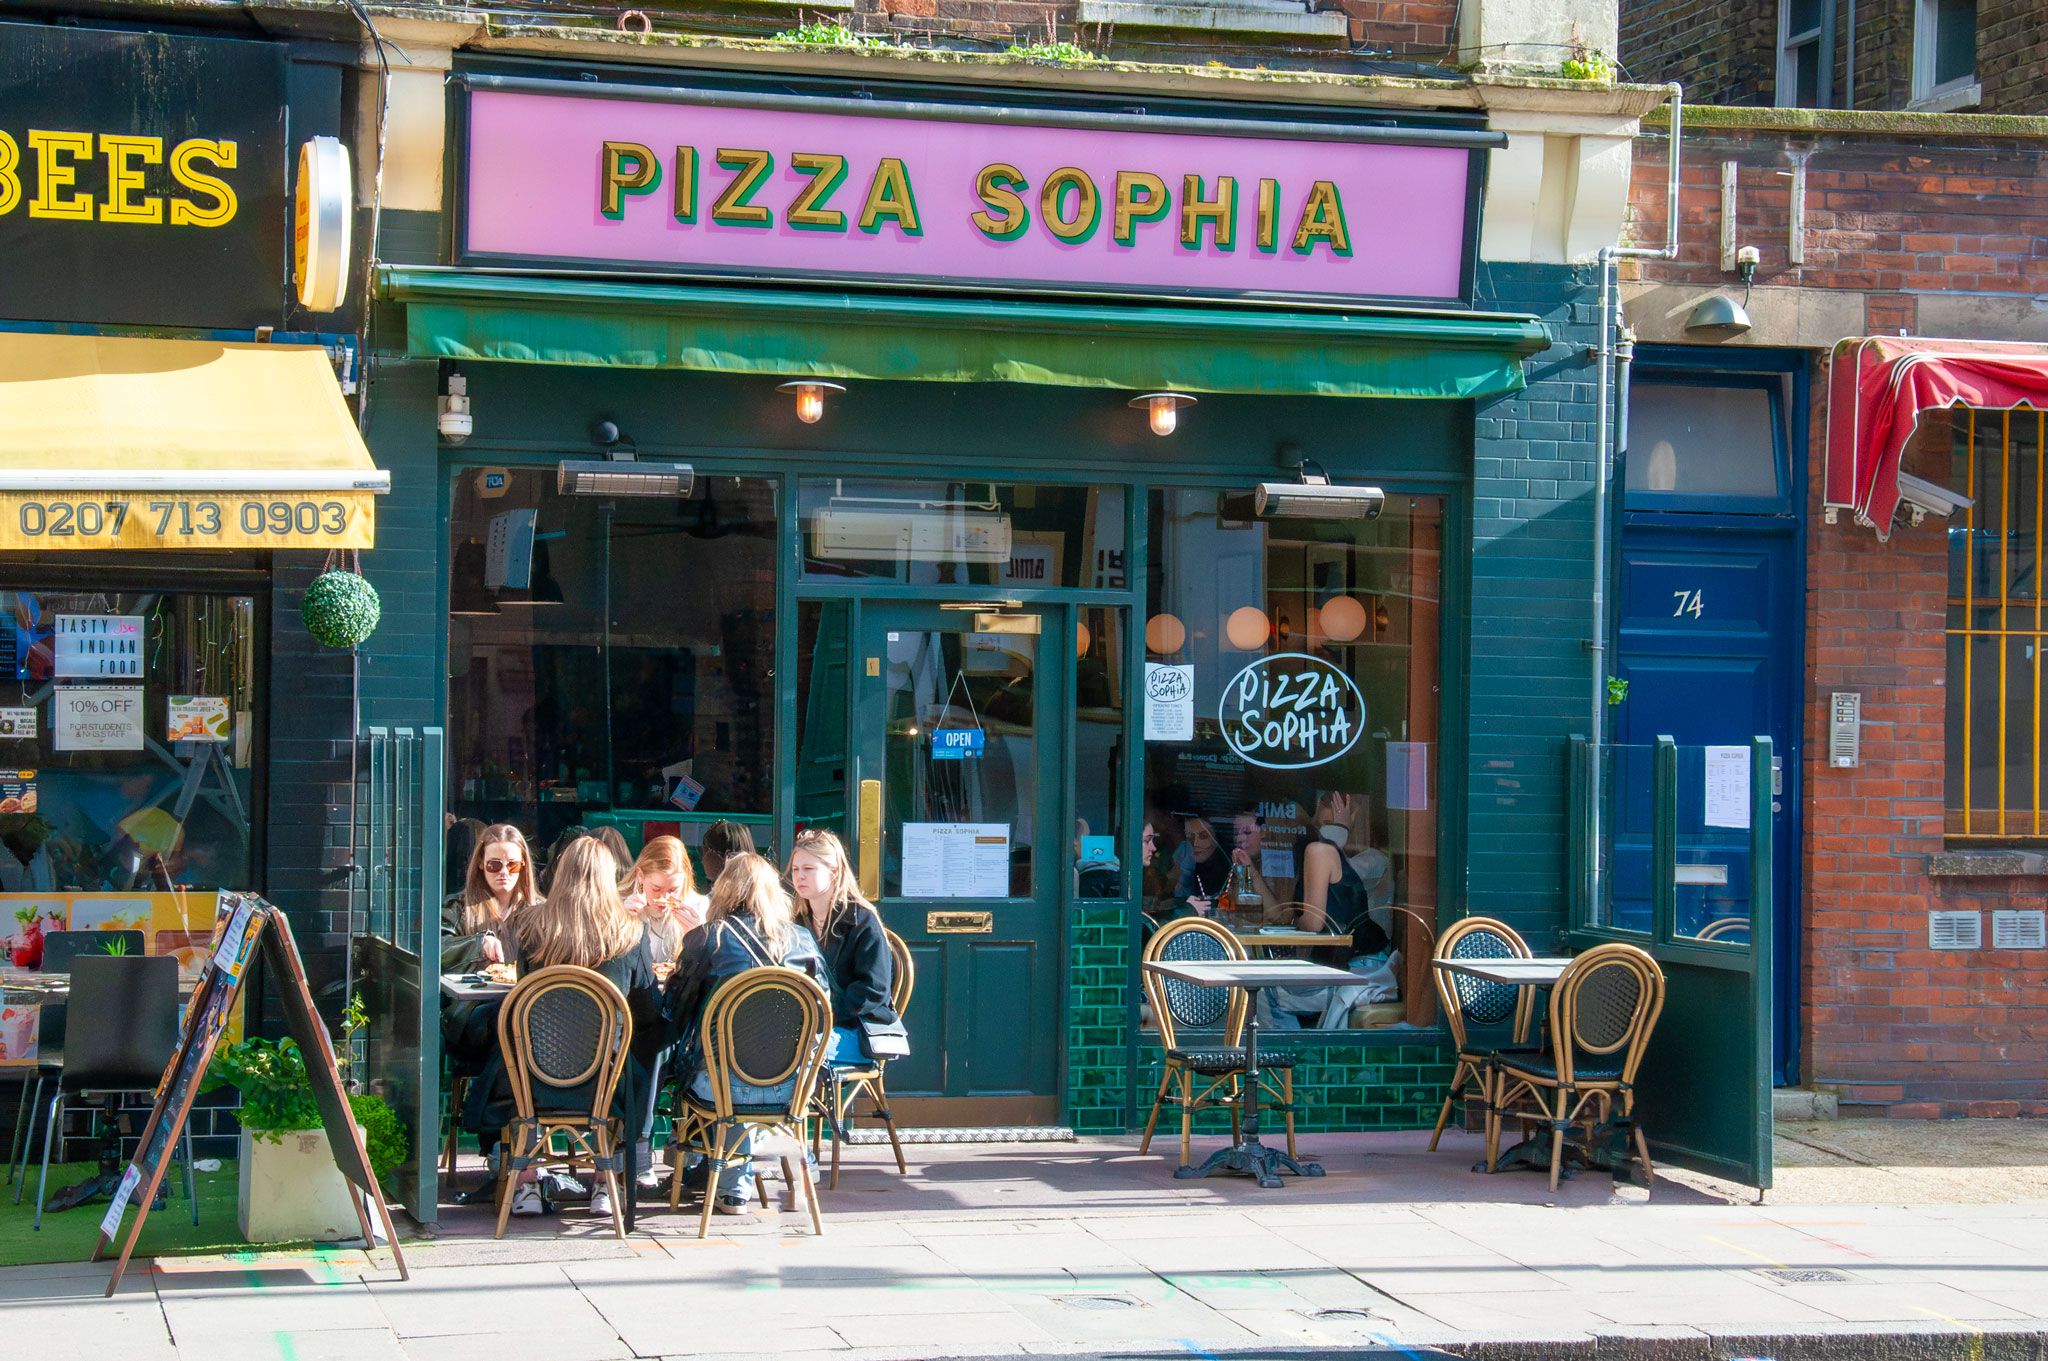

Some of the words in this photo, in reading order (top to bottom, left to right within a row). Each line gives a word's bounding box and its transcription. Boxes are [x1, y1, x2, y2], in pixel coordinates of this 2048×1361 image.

[600, 140, 923, 237] PIZZA
[971, 163, 1353, 257] SOPHIA
[19, 501, 129, 536] 0207
[149, 501, 222, 535] 713
[240, 501, 347, 535] 0903
[1673, 588, 1705, 619] 74
[60, 618, 109, 633] TASTY
[80, 639, 136, 654] INDIAN
[100, 659, 137, 674] FOOD
[69, 699, 98, 713] 10%
[101, 699, 133, 713] OFF
[88, 723, 133, 731] STUDENTS
[945, 732, 972, 747] OPEN
